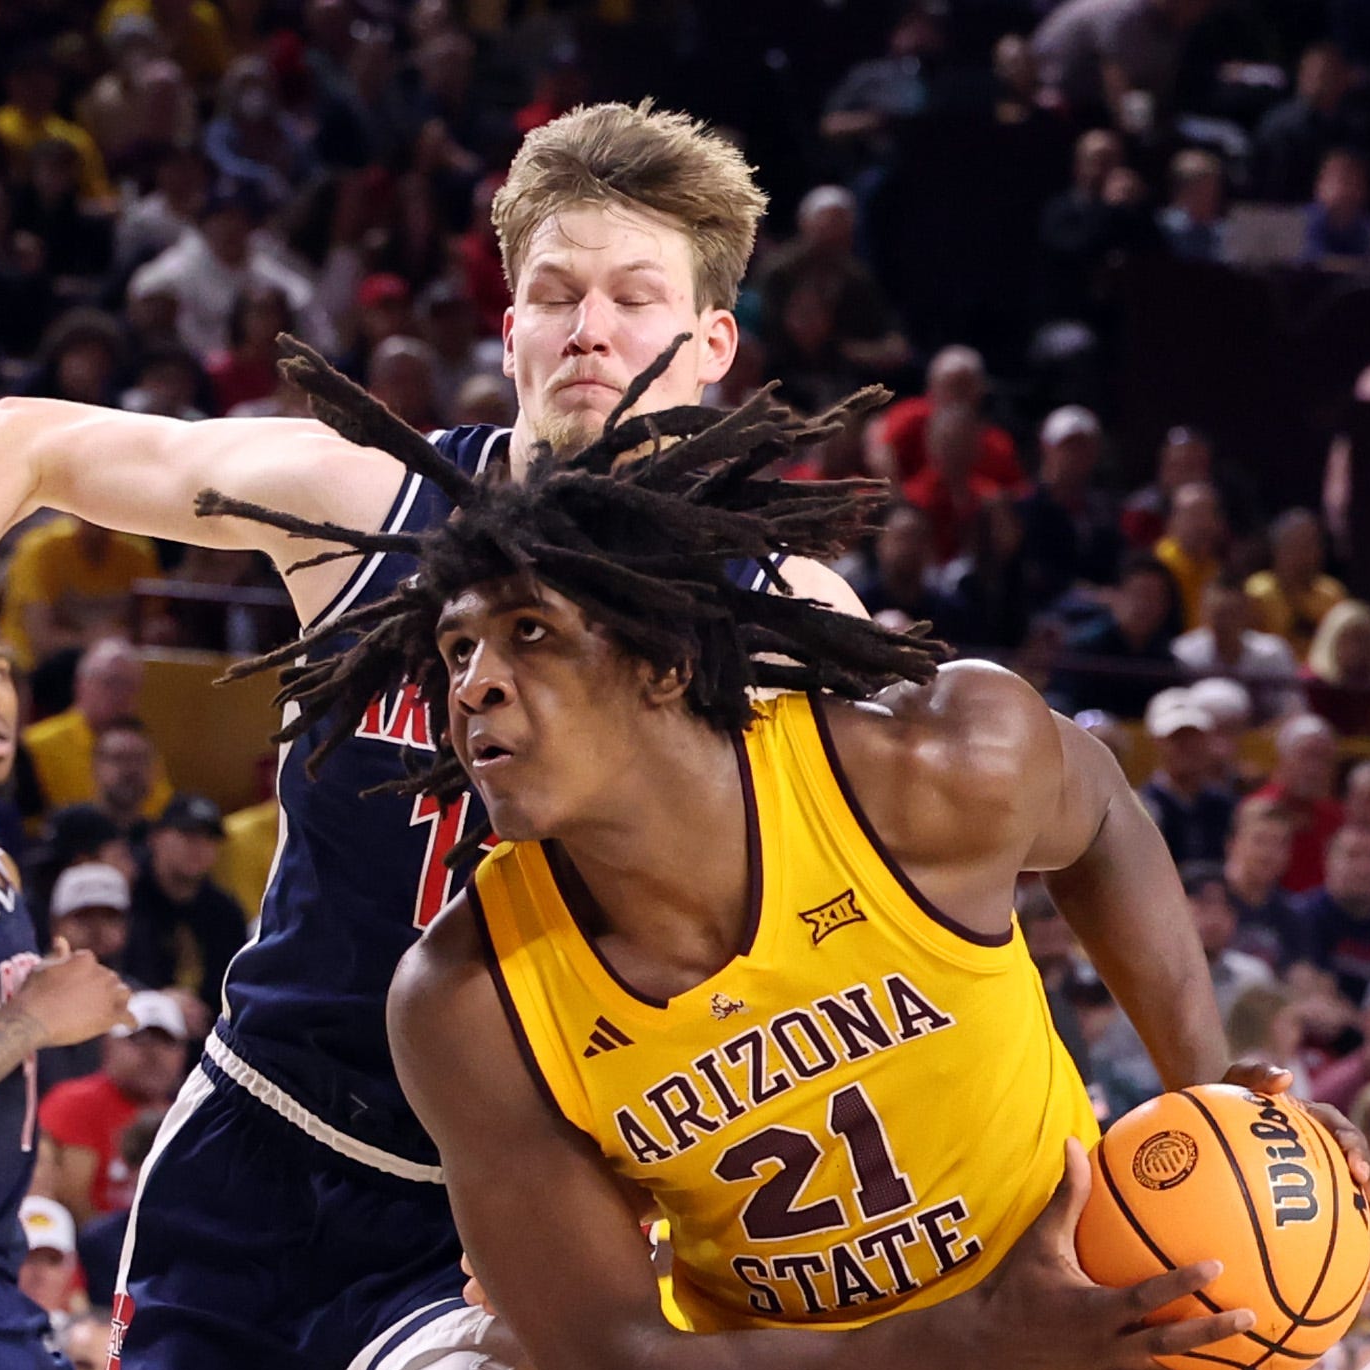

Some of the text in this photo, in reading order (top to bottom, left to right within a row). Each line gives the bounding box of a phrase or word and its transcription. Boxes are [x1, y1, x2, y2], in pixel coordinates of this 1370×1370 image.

[613, 973, 955, 1165] ARIZONA
[711, 1082, 916, 1240] 21
[1243, 1091, 1320, 1229] Wilso
[732, 1196, 983, 1316] STATE
